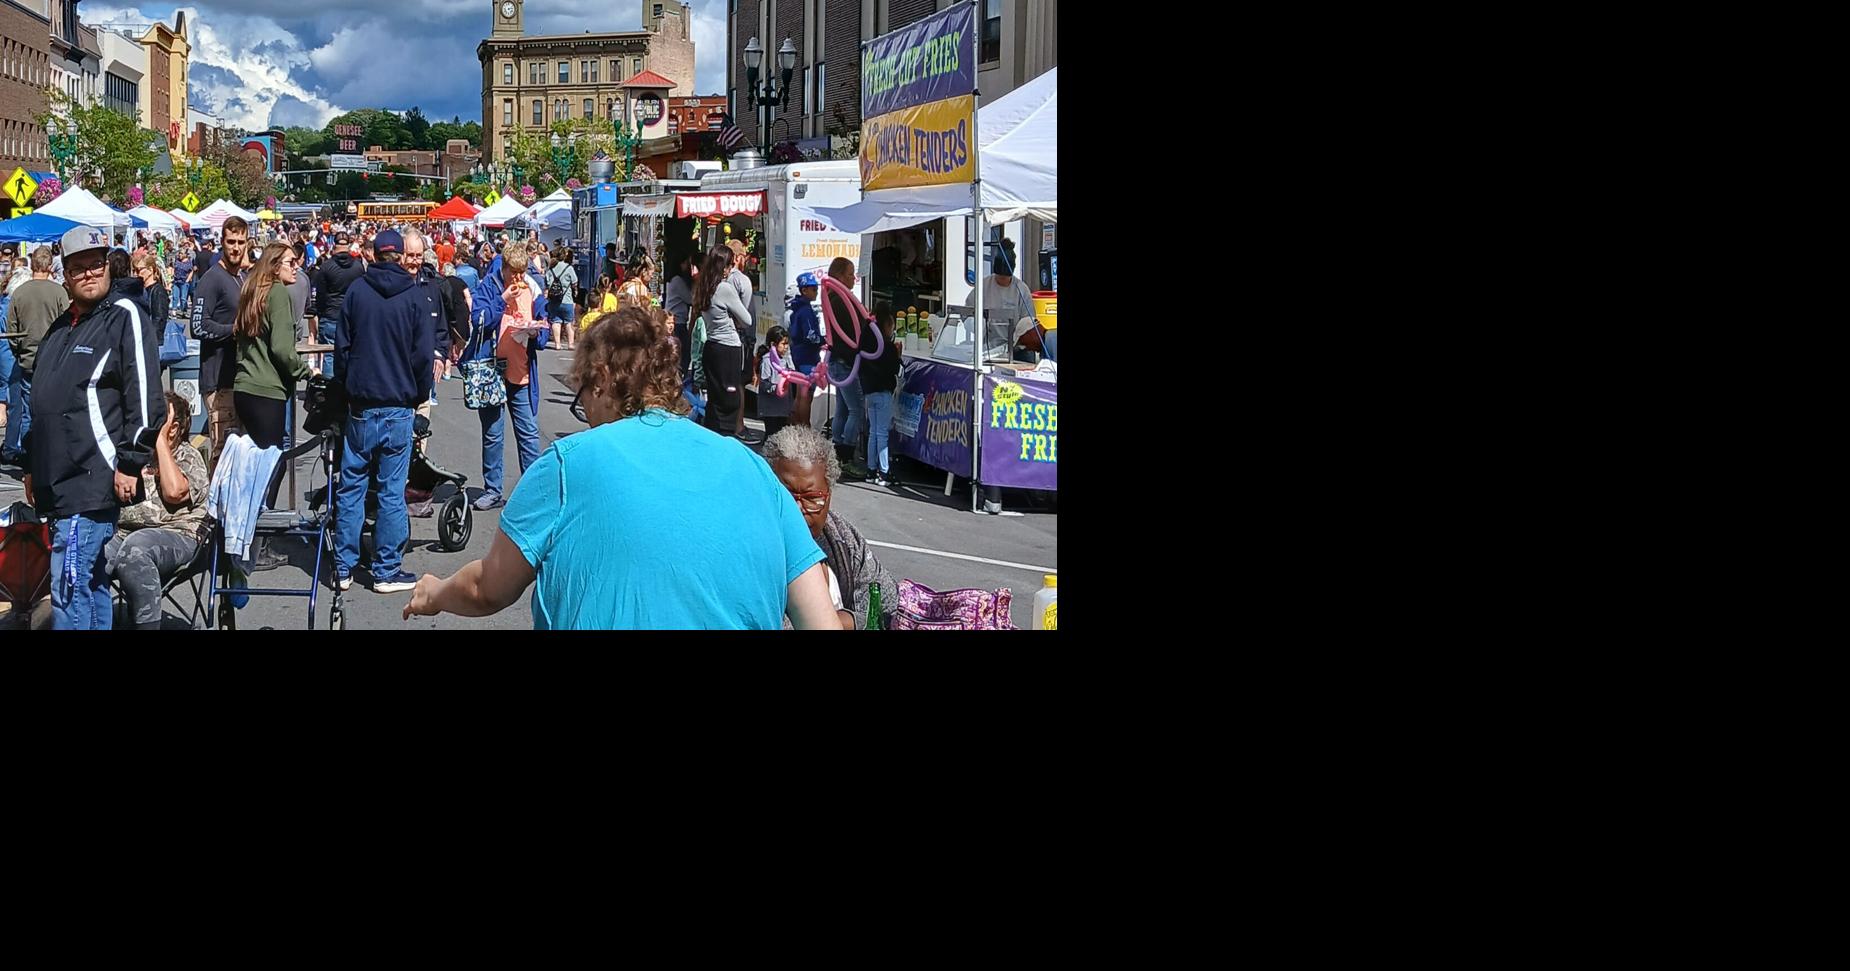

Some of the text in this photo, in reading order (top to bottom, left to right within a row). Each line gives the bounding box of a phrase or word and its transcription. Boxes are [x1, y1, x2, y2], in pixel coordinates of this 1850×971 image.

[899, 46, 920, 87] CUT
[923, 32, 960, 79] FRIES
[875, 119, 967, 174] CHICKEN TENDERS
[682, 196, 717, 213] FRIED
[931, 390, 967, 417] CHICKEN
[926, 414, 968, 448] TENDERS
